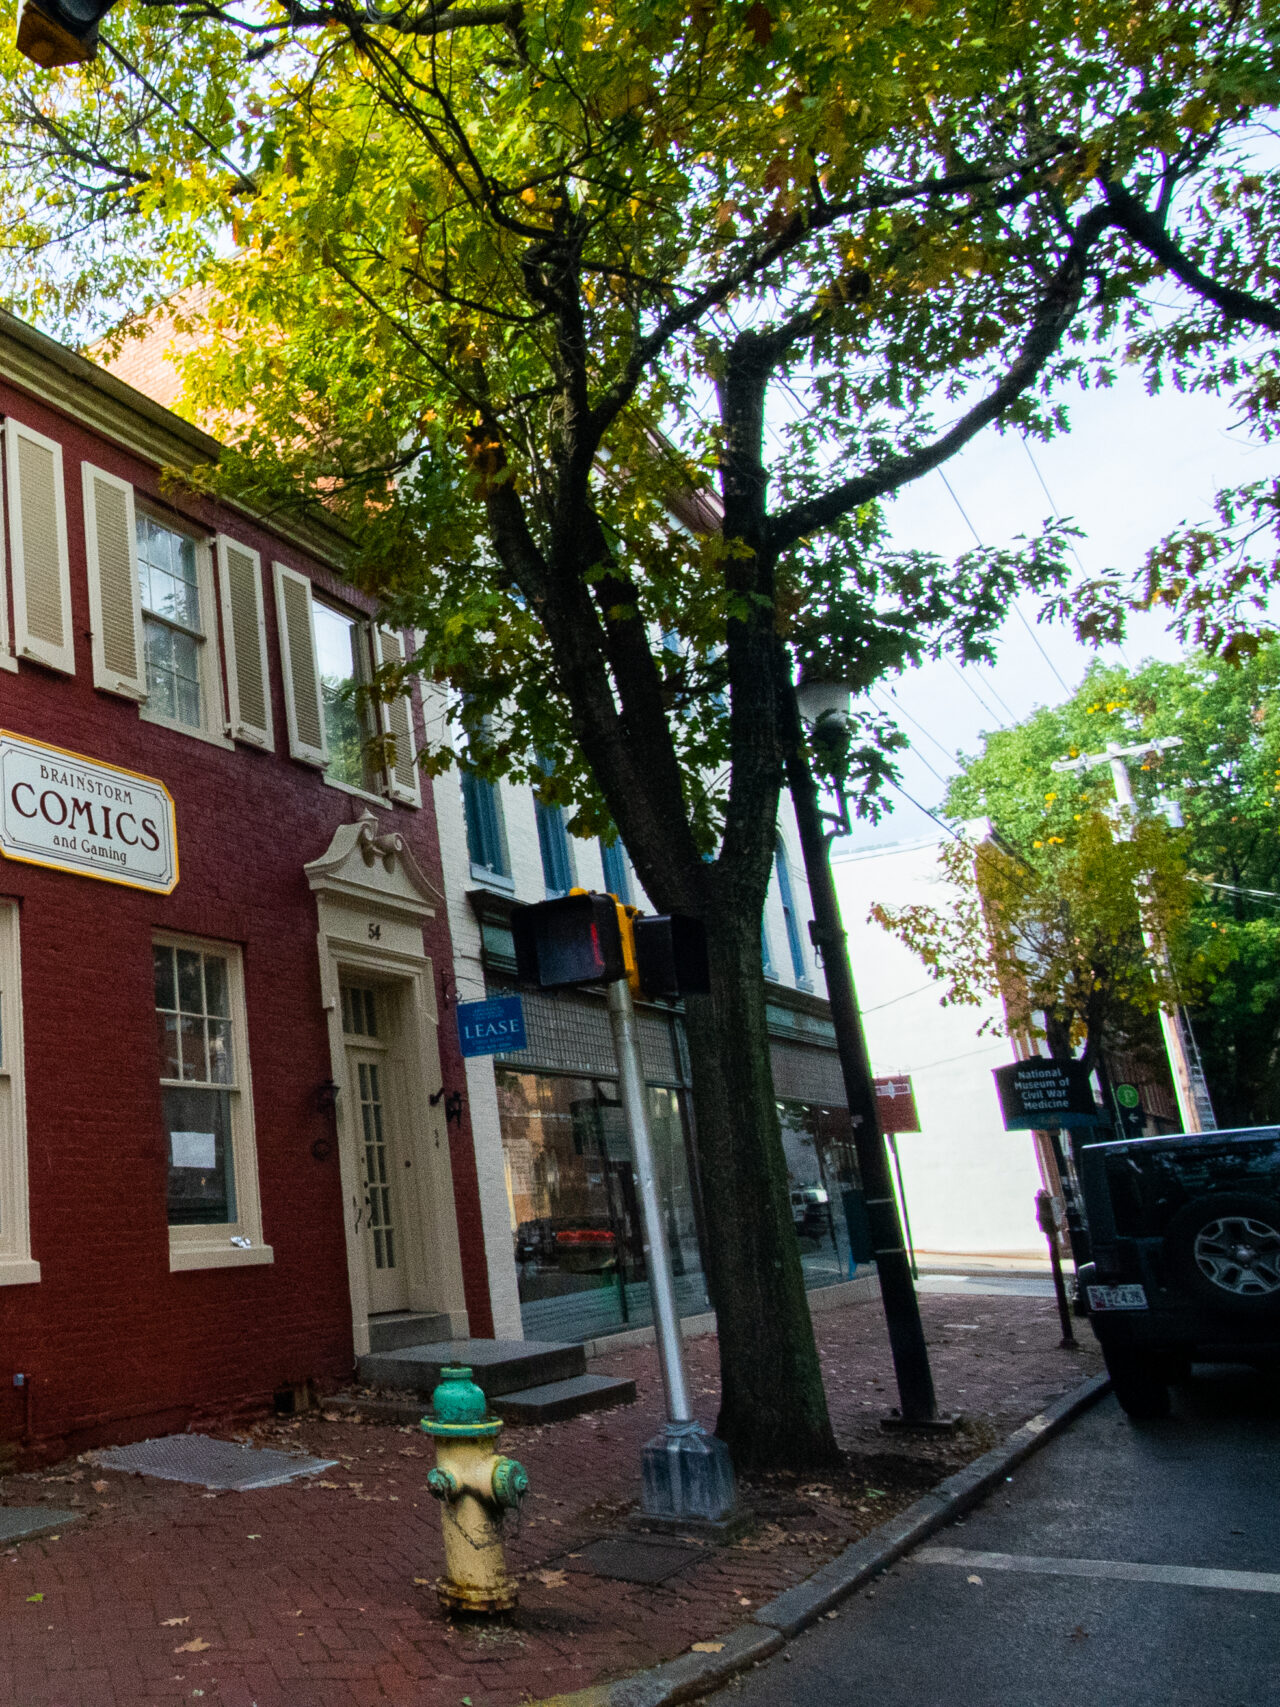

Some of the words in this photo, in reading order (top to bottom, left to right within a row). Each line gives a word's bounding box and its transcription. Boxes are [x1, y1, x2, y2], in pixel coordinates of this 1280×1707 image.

[39, 764, 133, 805] BRAINSTORM
[11, 782, 160, 851] COMICS
[53, 834, 77, 850] and
[81, 840, 127, 865] Gaming
[368, 923, 381, 940] 54
[464, 1018, 520, 1039] LEASE
[1018, 1068, 1061, 1079] National
[1014, 1080, 1056, 1090] Museum
[1059, 1077, 1070, 1087] of
[1021, 1089, 1044, 1100] Civil
[1046, 1089, 1067, 1098] War
[1024, 1099, 1069, 1110] Medicine
